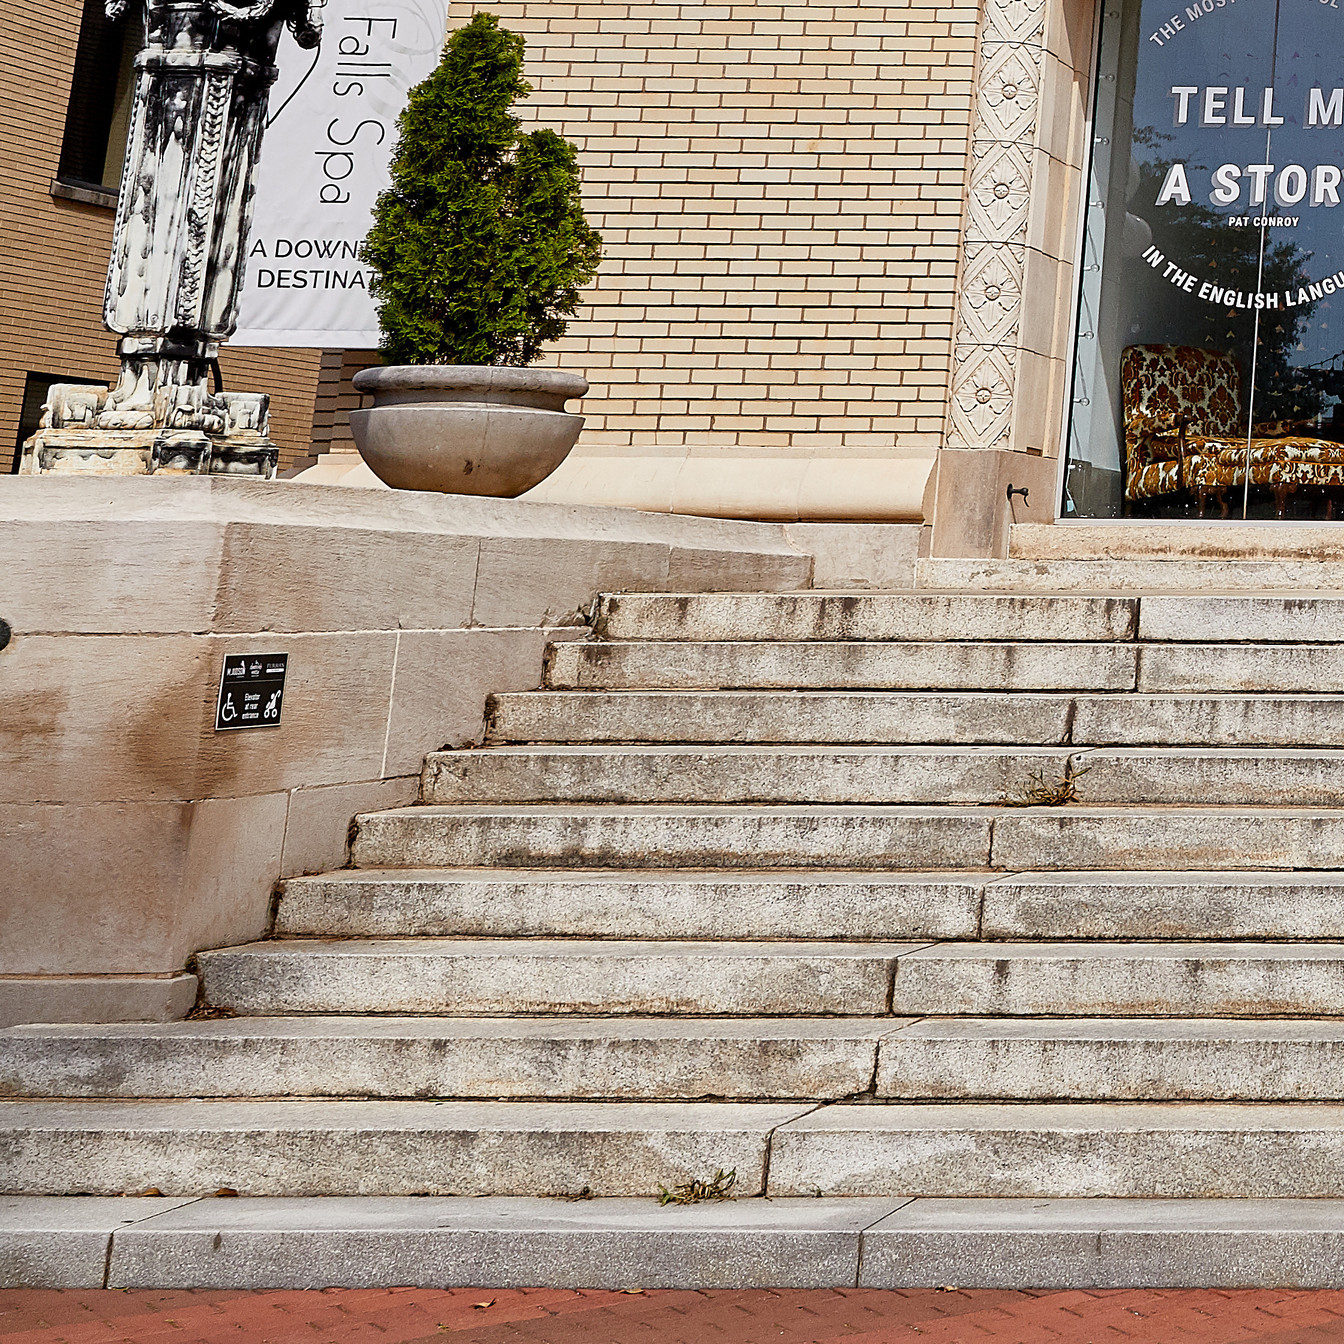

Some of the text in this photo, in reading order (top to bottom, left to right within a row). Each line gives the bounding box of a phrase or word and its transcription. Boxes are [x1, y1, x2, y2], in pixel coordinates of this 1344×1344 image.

[1149, 14, 1186, 48] THE
[333, 17, 397, 96] Falls
[1171, 86, 1285, 126] TELL
[315, 119, 385, 204] Spa
[1158, 163, 1192, 205] A
[1228, 216, 1300, 227] PAT CONROY
[249, 238, 268, 258] A
[1141, 244, 1165, 268] IN
[1162, 261, 1199, 293] THE
[1198, 282, 1279, 310] ENGLISH
